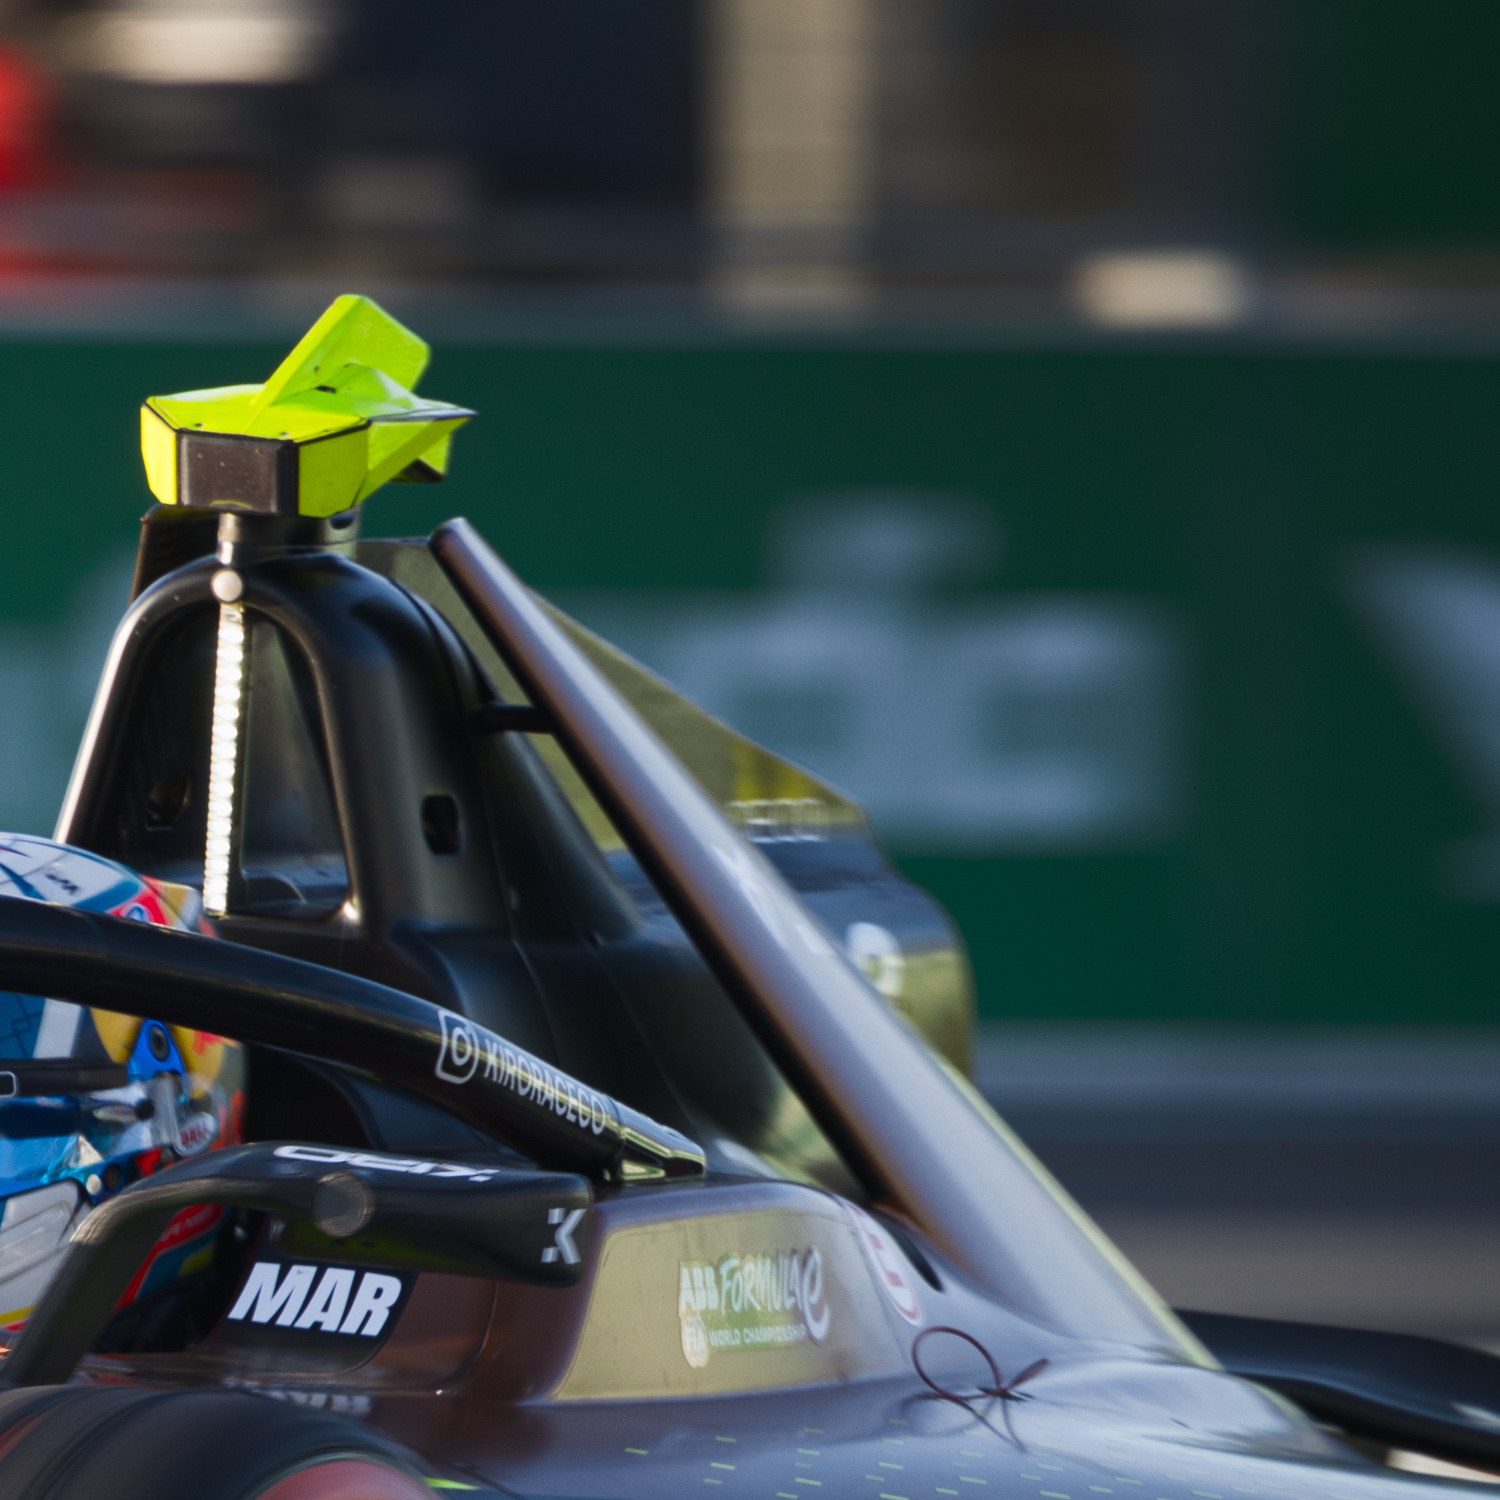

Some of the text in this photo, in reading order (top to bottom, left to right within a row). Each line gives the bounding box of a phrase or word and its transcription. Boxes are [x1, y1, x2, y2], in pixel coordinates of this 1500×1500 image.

[483, 1038, 607, 1136] KIRORACECO
[226, 1261, 402, 1338] MAR
[717, 1252, 804, 1316] FORMULA
[708, 1328, 741, 1347] WORLD
